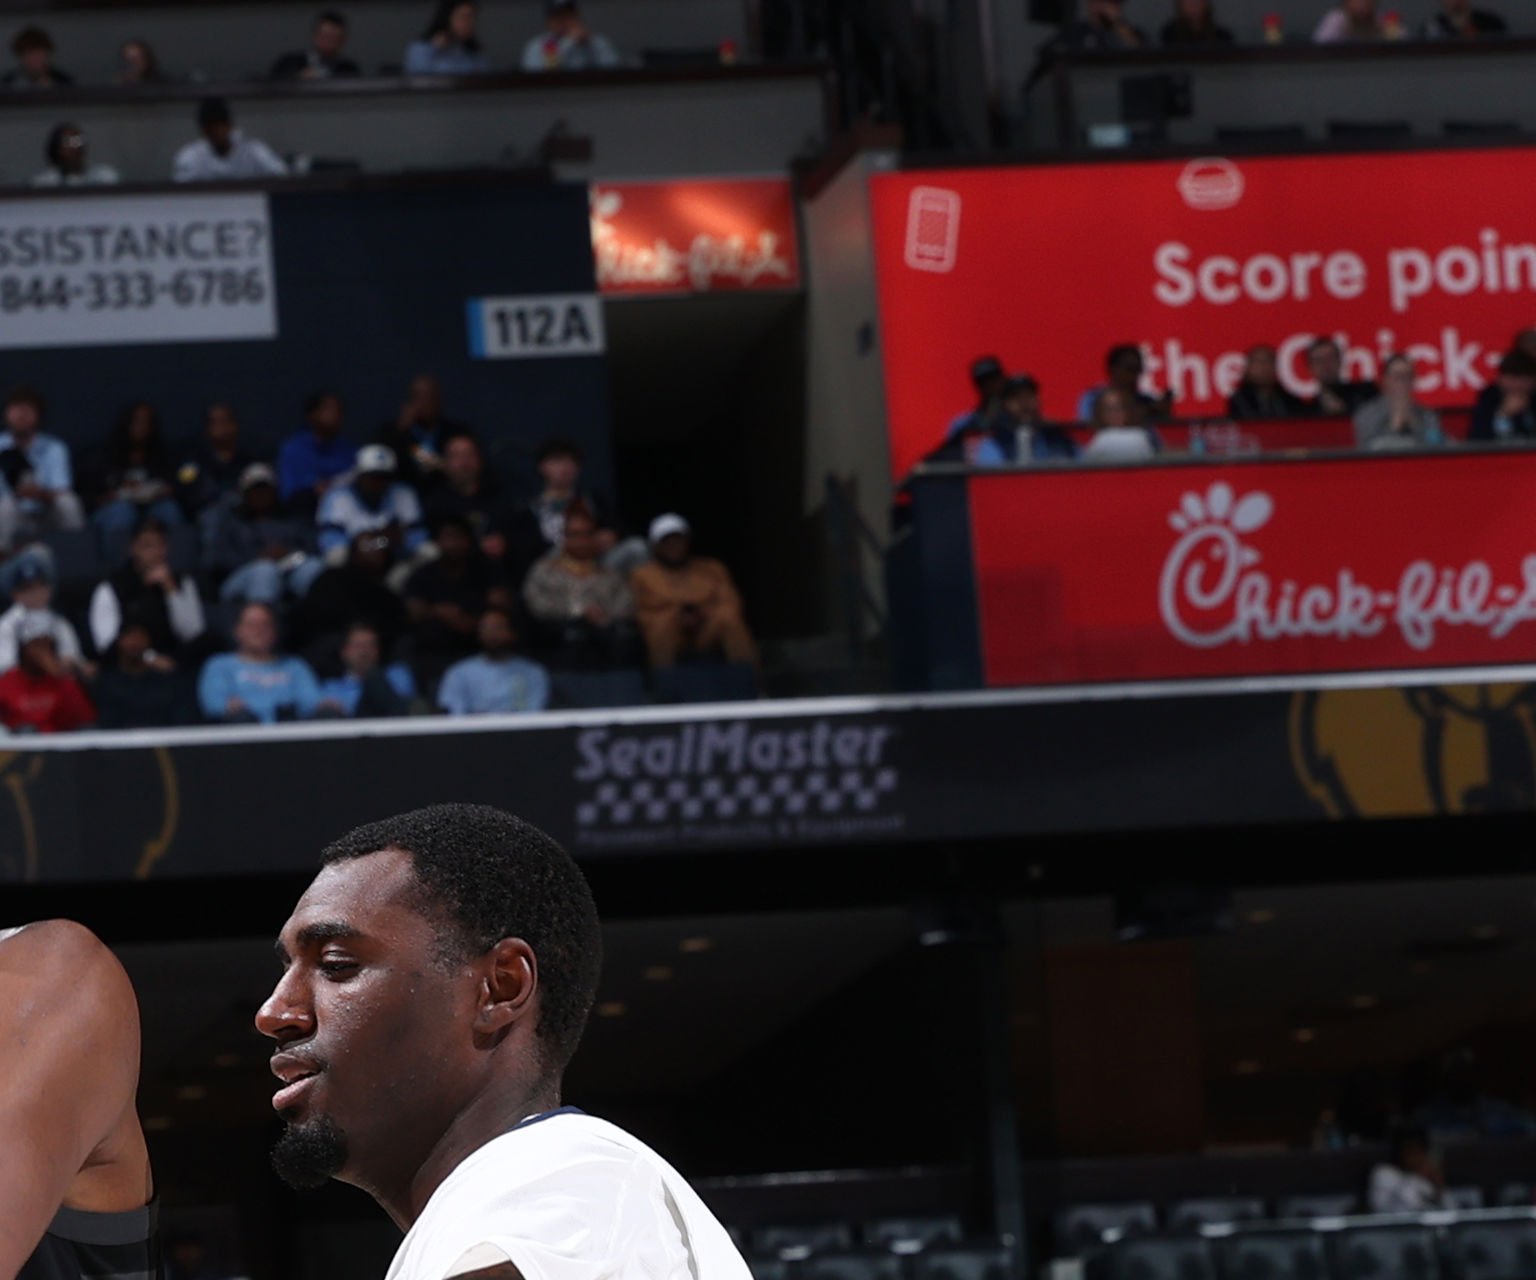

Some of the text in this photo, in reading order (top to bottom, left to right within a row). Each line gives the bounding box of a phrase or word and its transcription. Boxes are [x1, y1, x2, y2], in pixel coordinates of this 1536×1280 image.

[1154, 242, 1367, 307] Score
[491, 303, 593, 350] 112A
[573, 720, 891, 782] SealMaster
